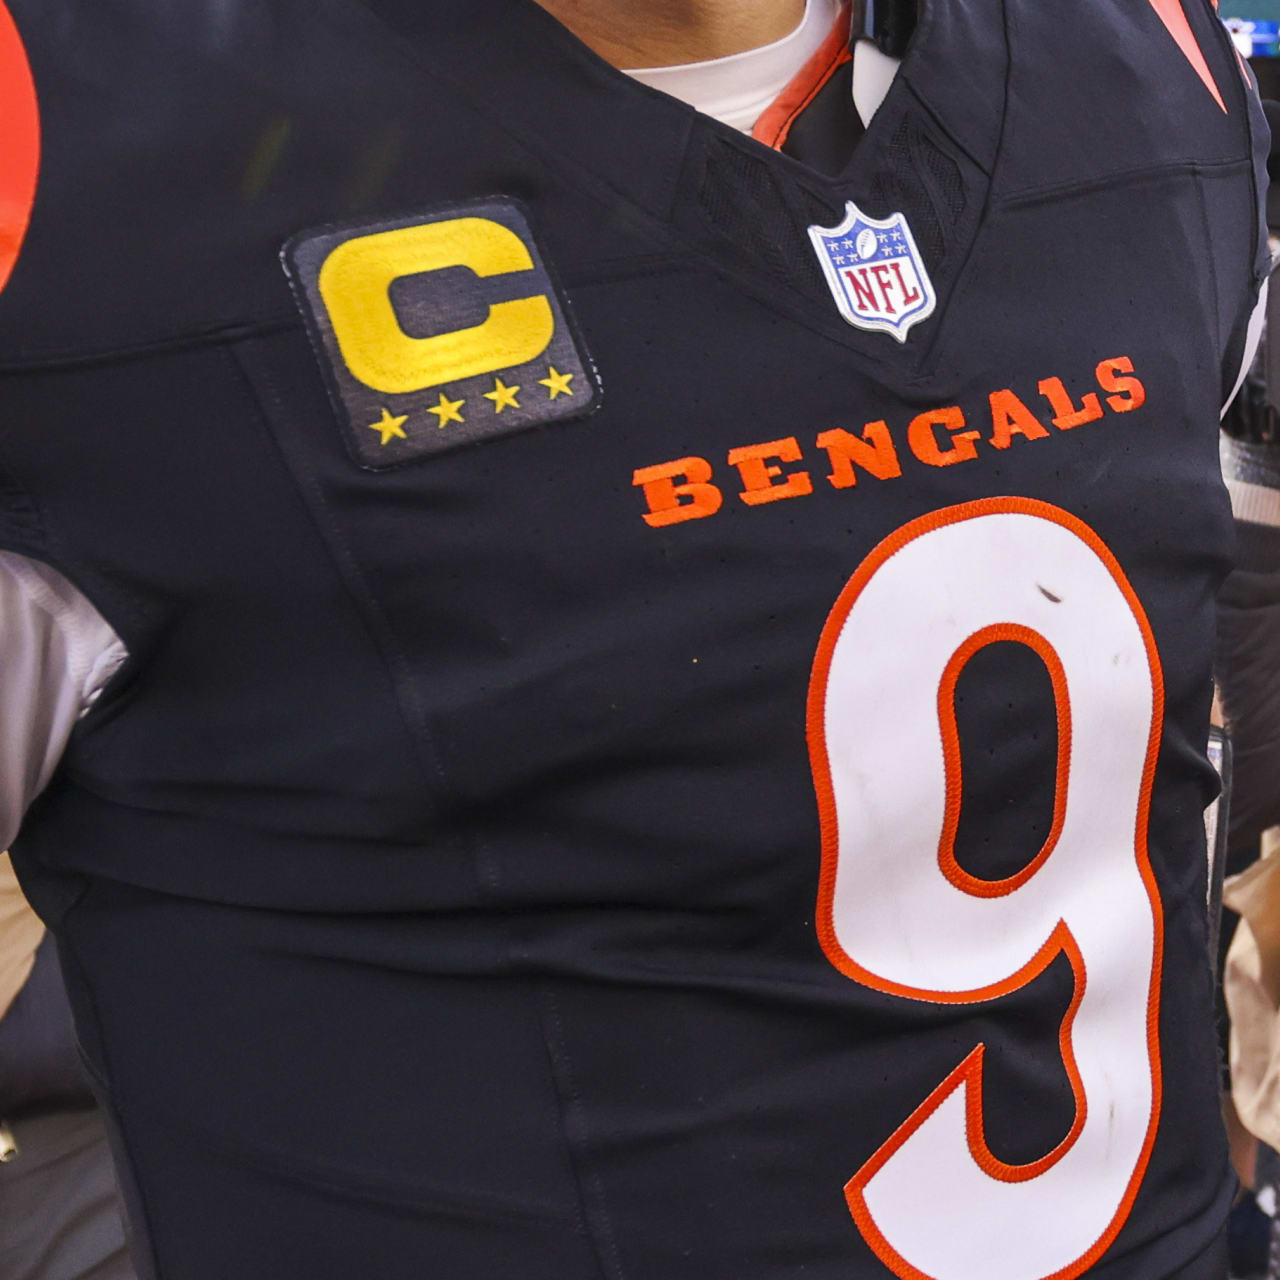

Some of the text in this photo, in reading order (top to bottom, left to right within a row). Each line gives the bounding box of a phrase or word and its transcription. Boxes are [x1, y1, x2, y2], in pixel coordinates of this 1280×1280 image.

[317, 215, 556, 395] C
[844, 261, 920, 314] NFL
[631, 355, 1146, 528] BENGALS
